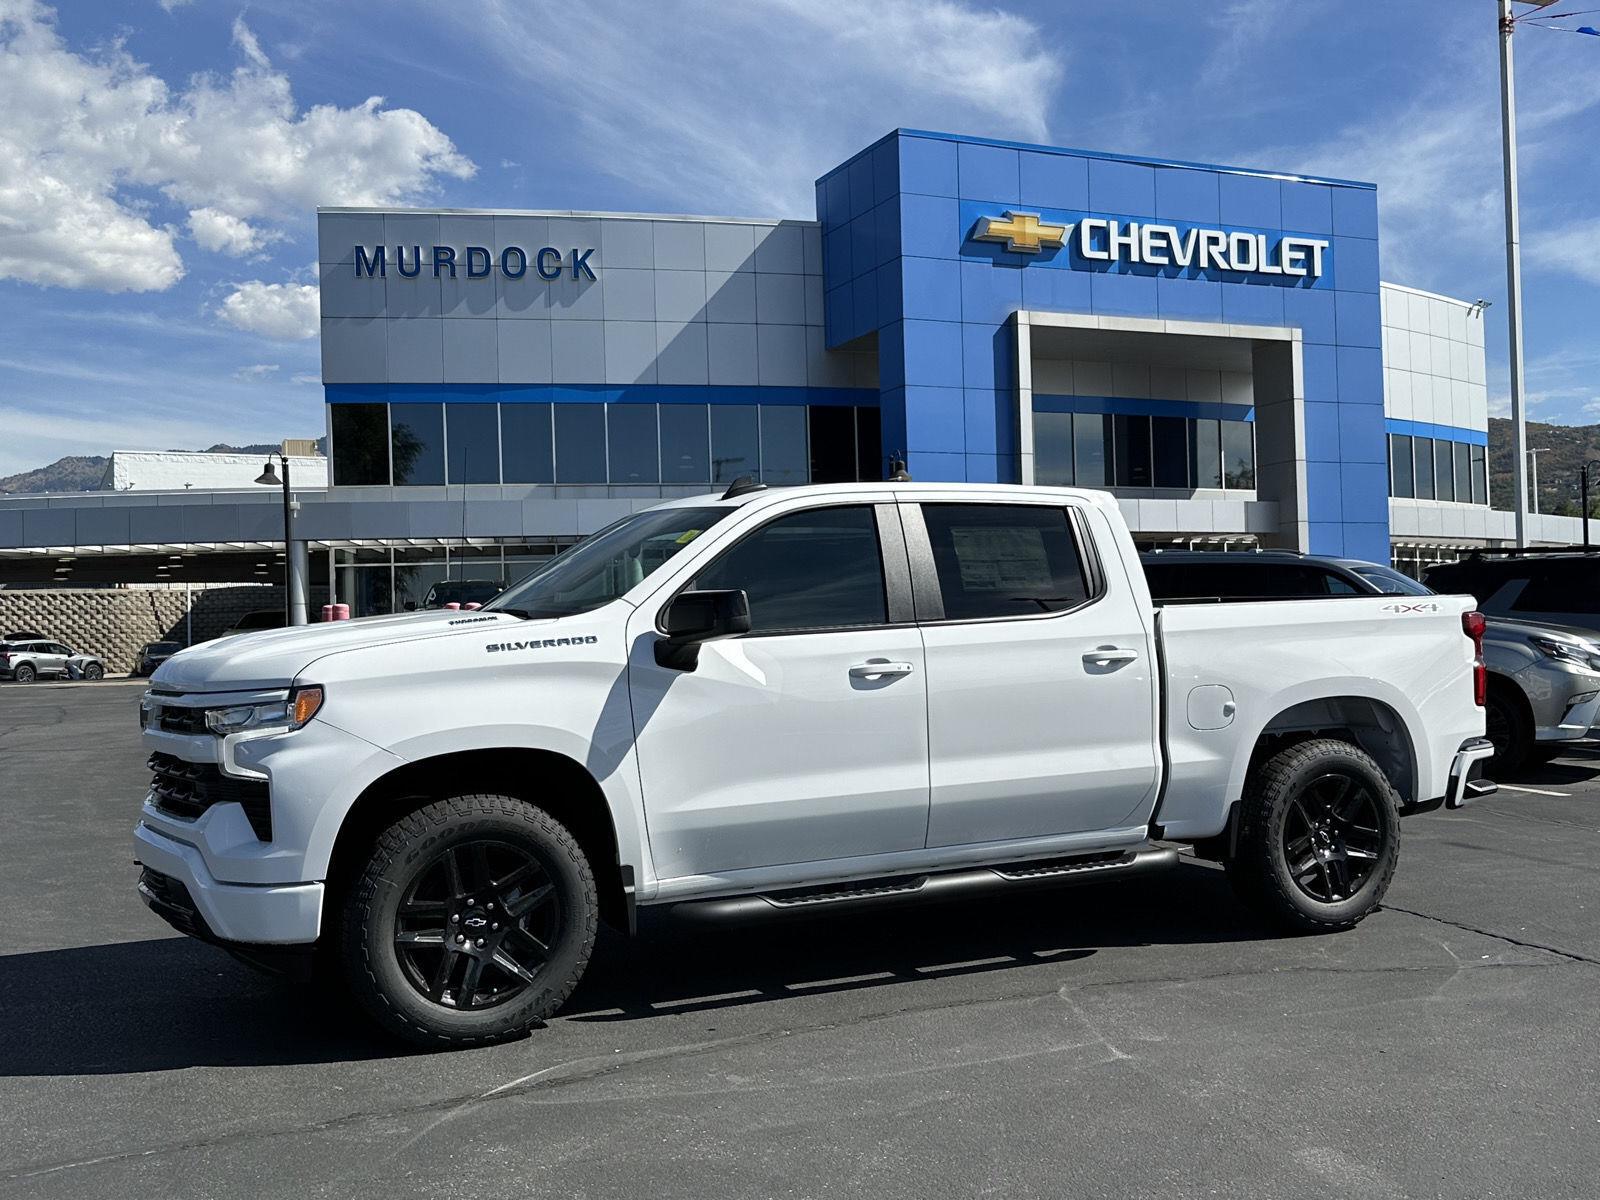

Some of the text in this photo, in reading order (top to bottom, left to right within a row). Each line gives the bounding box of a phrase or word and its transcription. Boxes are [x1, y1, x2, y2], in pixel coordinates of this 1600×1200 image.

[354, 245, 597, 281] MURDOCK
[1080, 217, 1330, 277] CHEVROLET
[485, 635, 599, 653] SILVERADO
